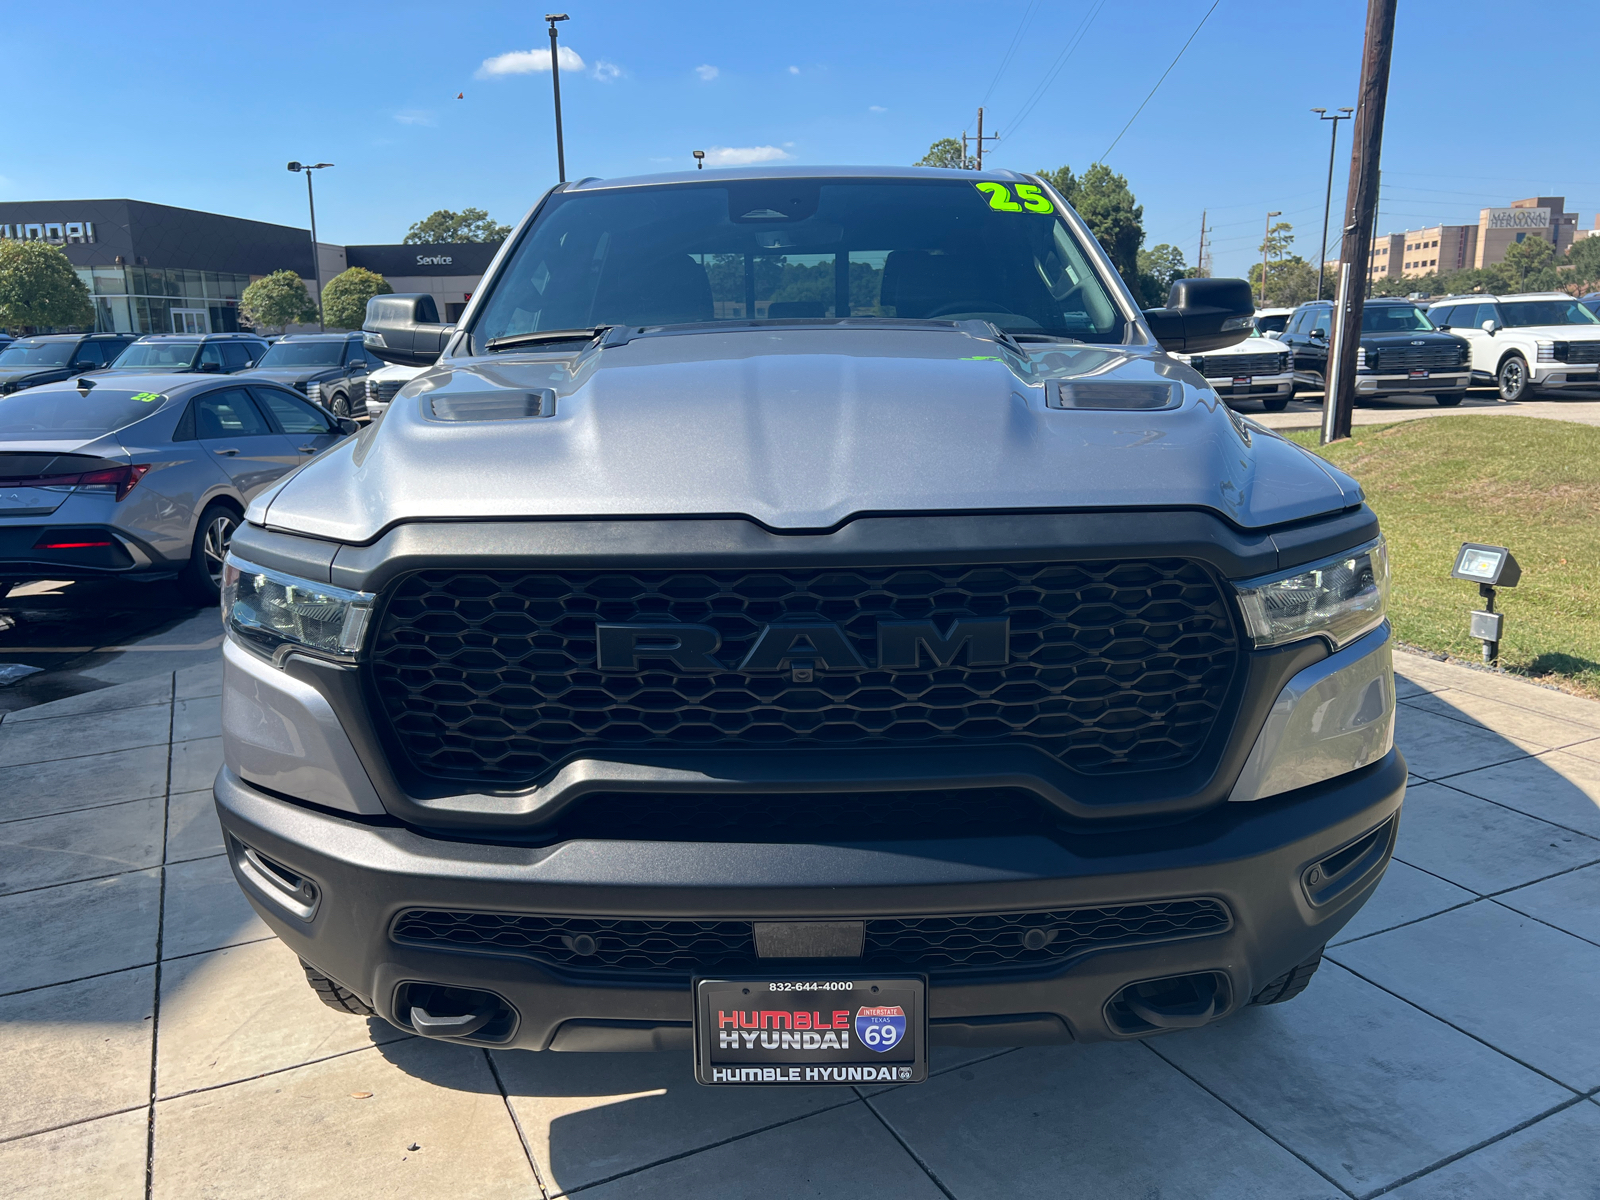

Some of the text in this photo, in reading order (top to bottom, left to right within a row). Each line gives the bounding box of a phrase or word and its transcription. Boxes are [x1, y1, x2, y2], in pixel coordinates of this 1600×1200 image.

[975, 182, 1054, 214] 25
[1490, 217, 1548, 228] HERMANN
[0, 222, 94, 244] UNDAI
[416, 255, 452, 265] Service
[130, 392, 160, 402] 25
[595, 616, 1010, 671] RAM
[769, 981, 853, 992] 832-644-4000
[718, 1010, 850, 1030] HUMBLE
[863, 1008, 898, 1016] INTERSTATE
[719, 1030, 849, 1050] HYUNDAI
[864, 1025, 897, 1045] 69
[712, 1066, 897, 1082] HUMBLE HYUNDAI
